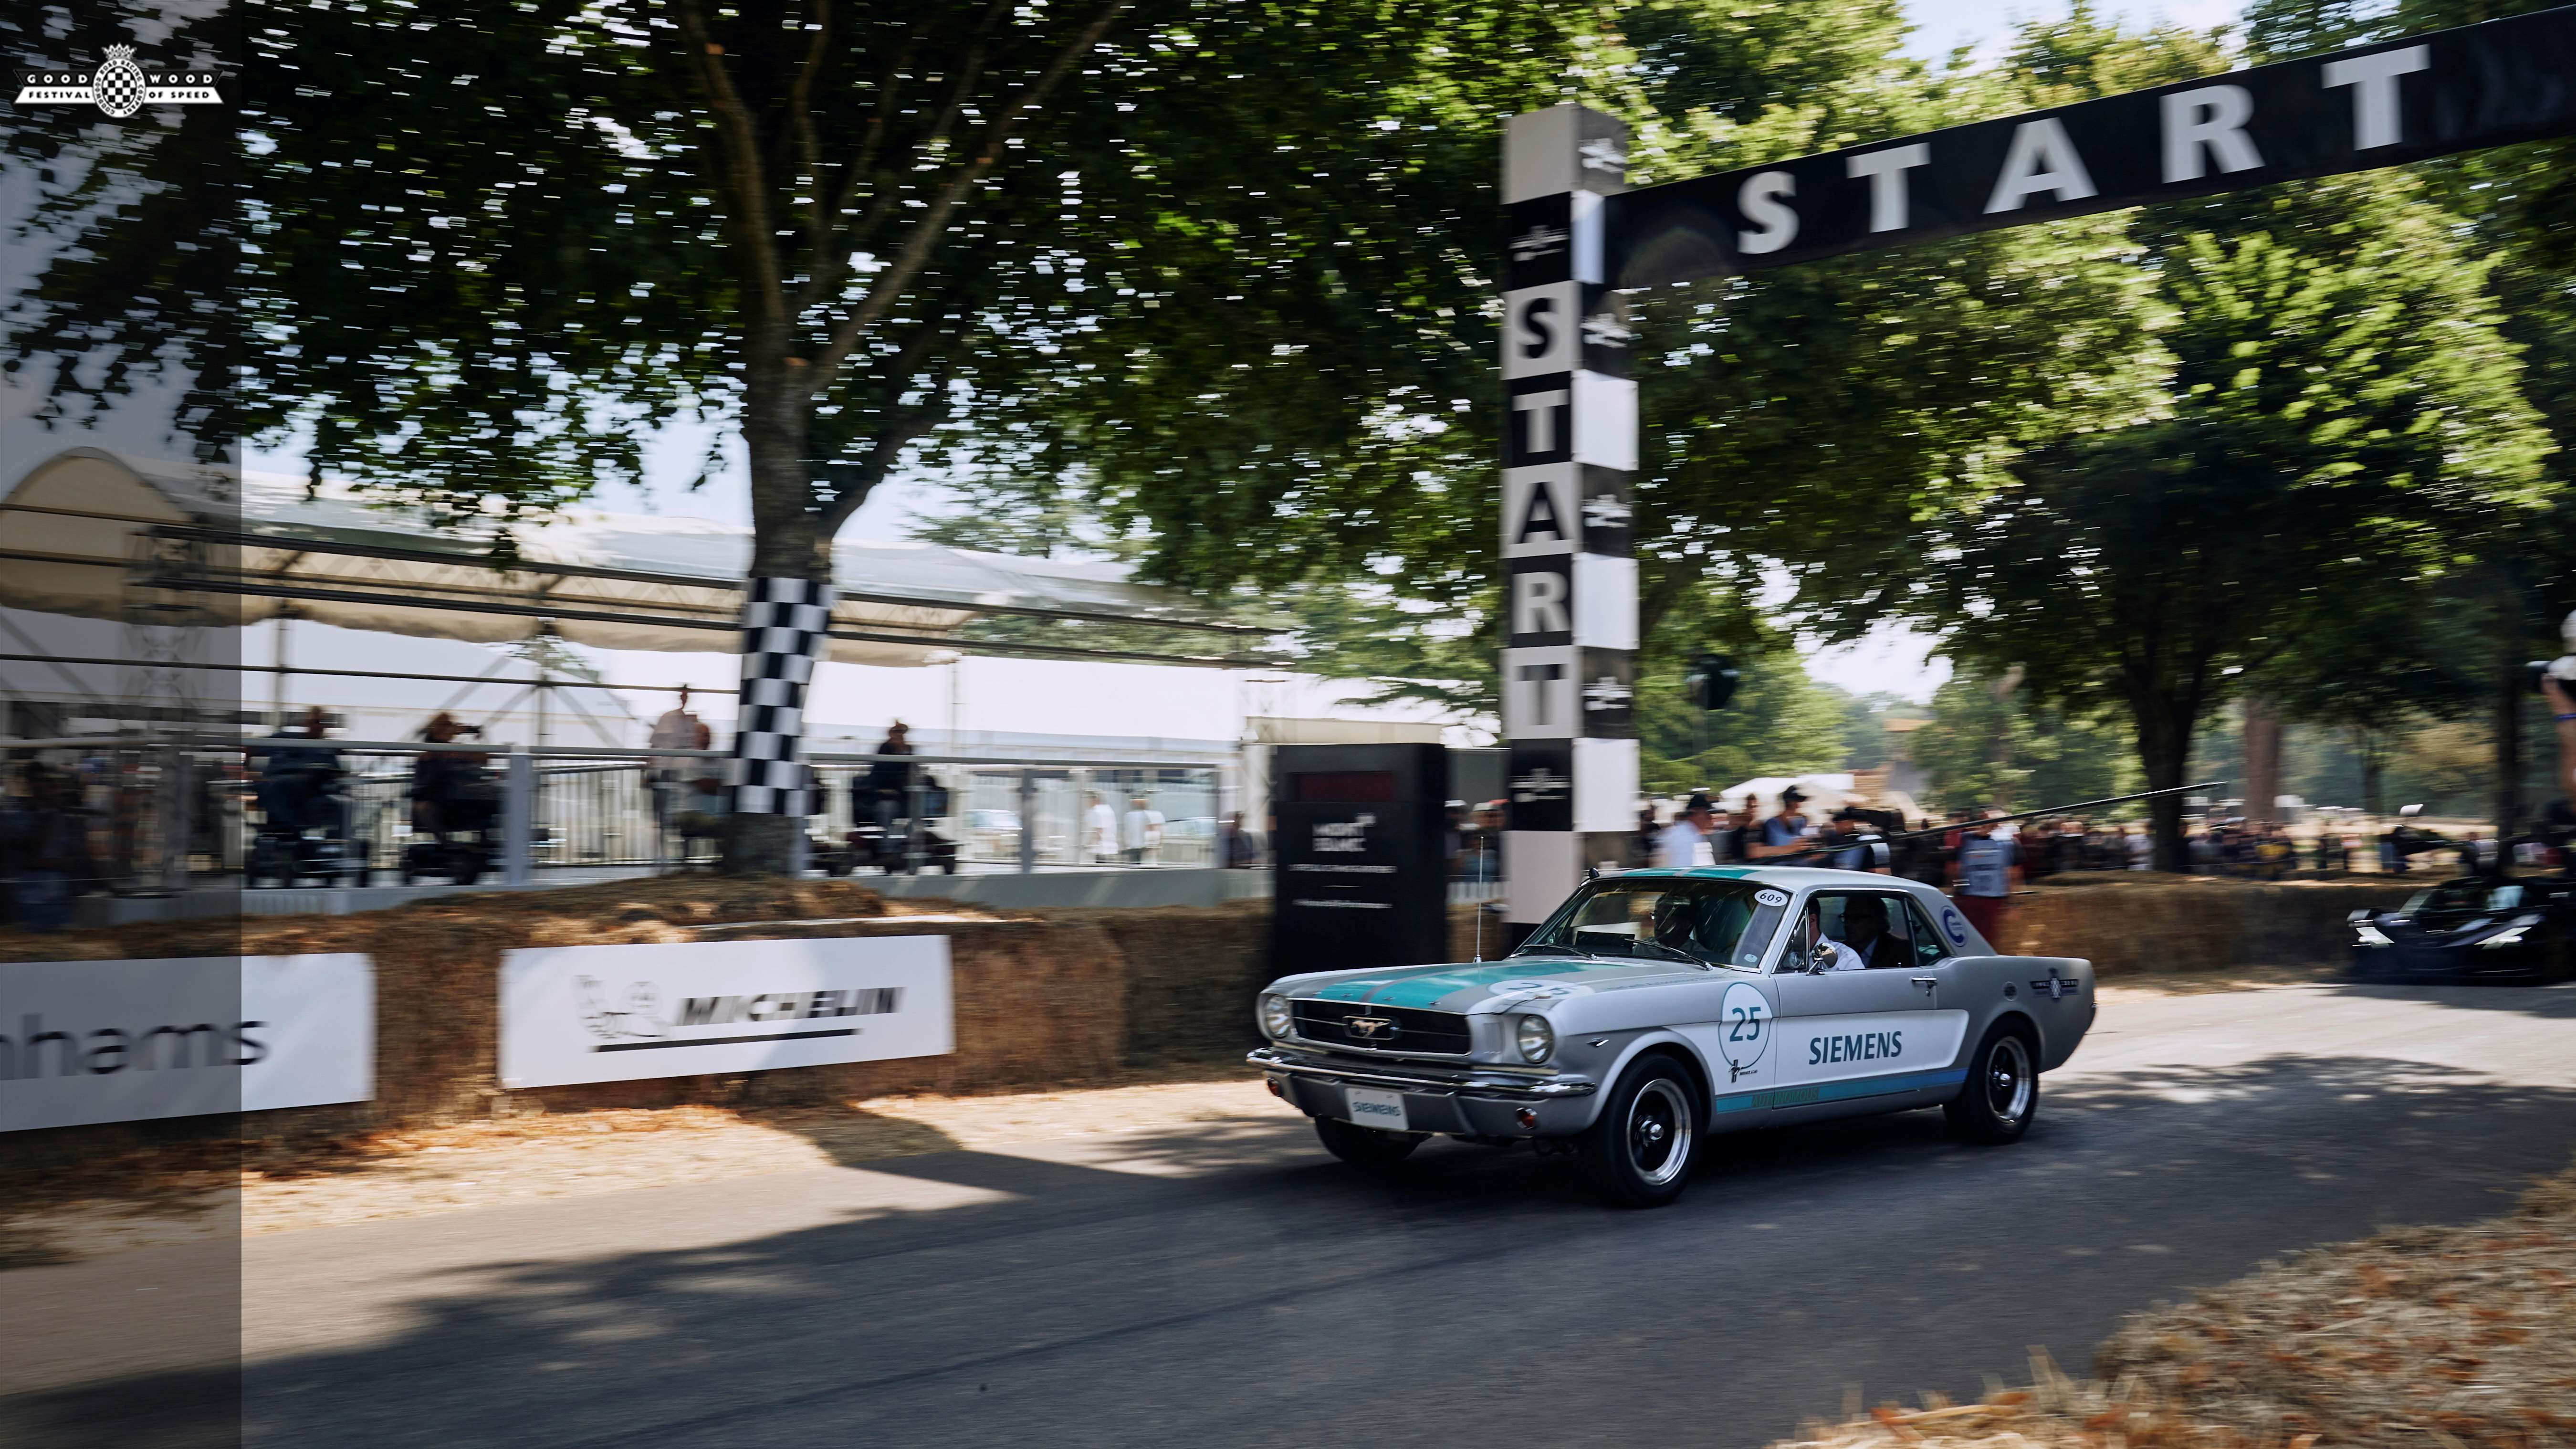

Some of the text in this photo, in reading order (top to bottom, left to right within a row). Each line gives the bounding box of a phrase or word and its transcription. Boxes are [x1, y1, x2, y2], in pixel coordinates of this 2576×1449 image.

[1737, 44, 2431, 254] START
[1512, 297, 1571, 725] START
[1759, 892, 1782, 903] 609
[672, 987, 906, 1027] MICHELIN
[1729, 1006, 1761, 1042] 25
[0, 1007, 265, 1080] hams
[1809, 1030, 1902, 1065] SIEMENS
[1751, 1087, 1819, 1108] AUTONOMOUS
